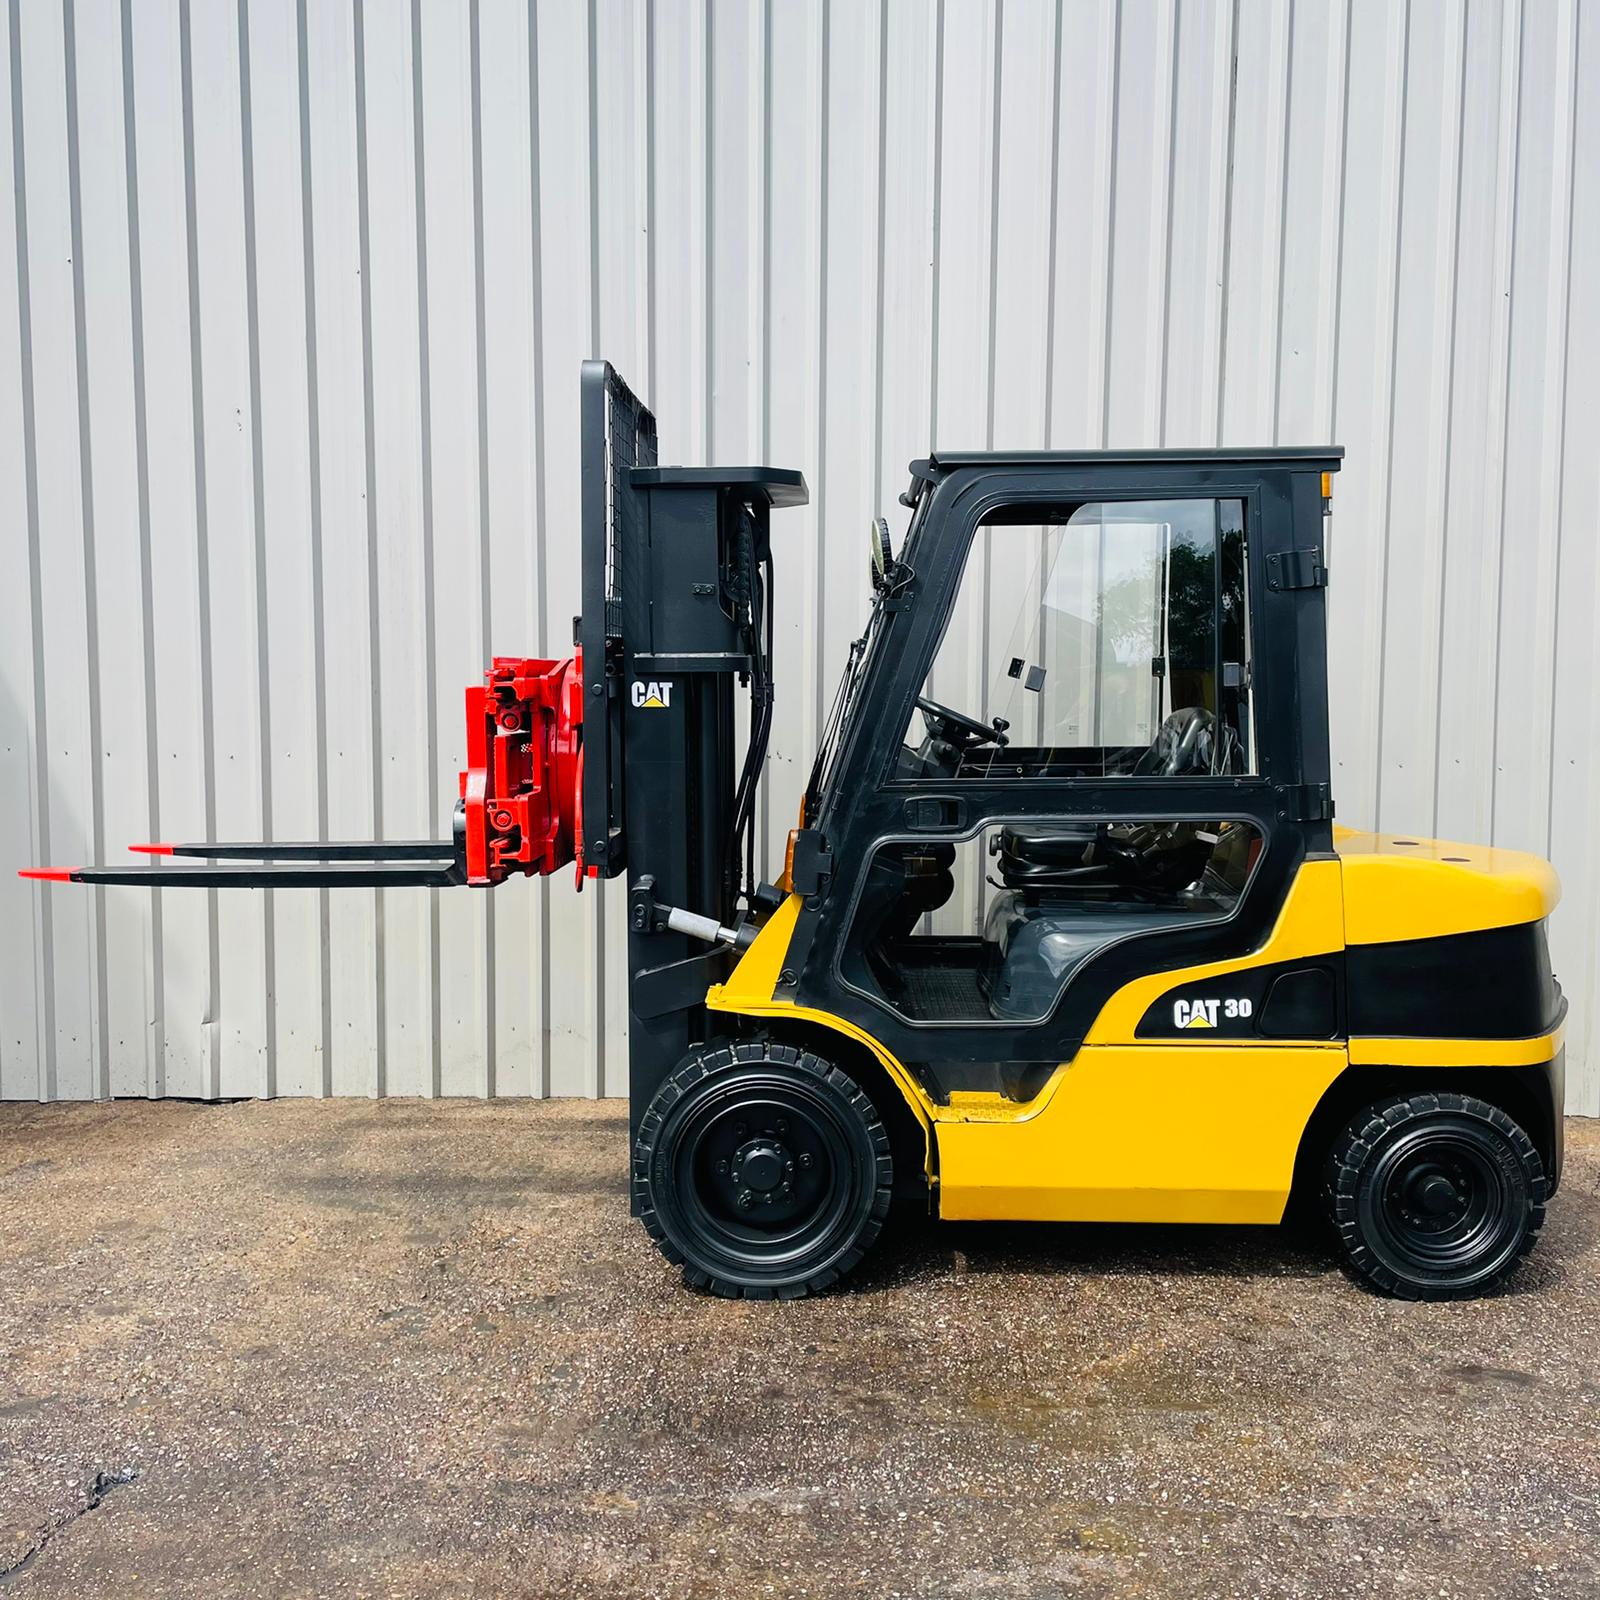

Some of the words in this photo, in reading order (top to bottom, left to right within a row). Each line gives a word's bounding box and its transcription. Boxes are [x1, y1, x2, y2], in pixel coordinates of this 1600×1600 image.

[631, 681, 673, 708] CAT
[1174, 999, 1220, 1029] CAT
[1224, 998, 1252, 1018] 30
